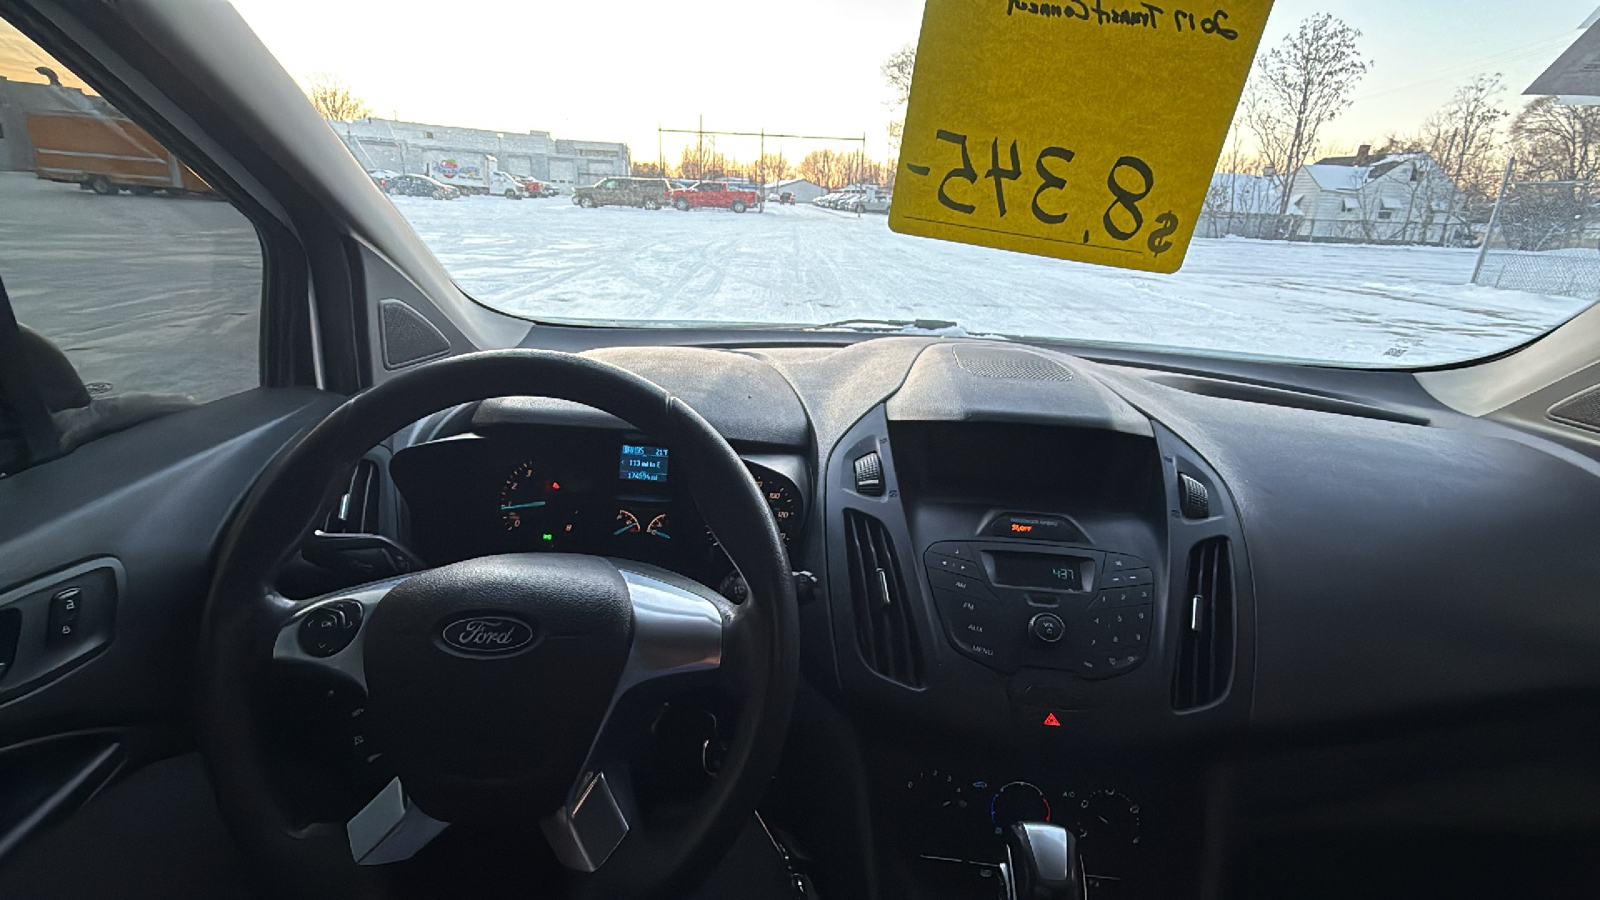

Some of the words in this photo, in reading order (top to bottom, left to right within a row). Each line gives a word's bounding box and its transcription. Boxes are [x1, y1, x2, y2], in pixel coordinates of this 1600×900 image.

[1052, 567, 1075, 581] 437
[955, 581, 967, 589] AM
[962, 601, 975, 611] FM
[458, 620, 516, 644] Ford
[967, 623, 985, 634] AUX
[972, 644, 995, 656] MENU
